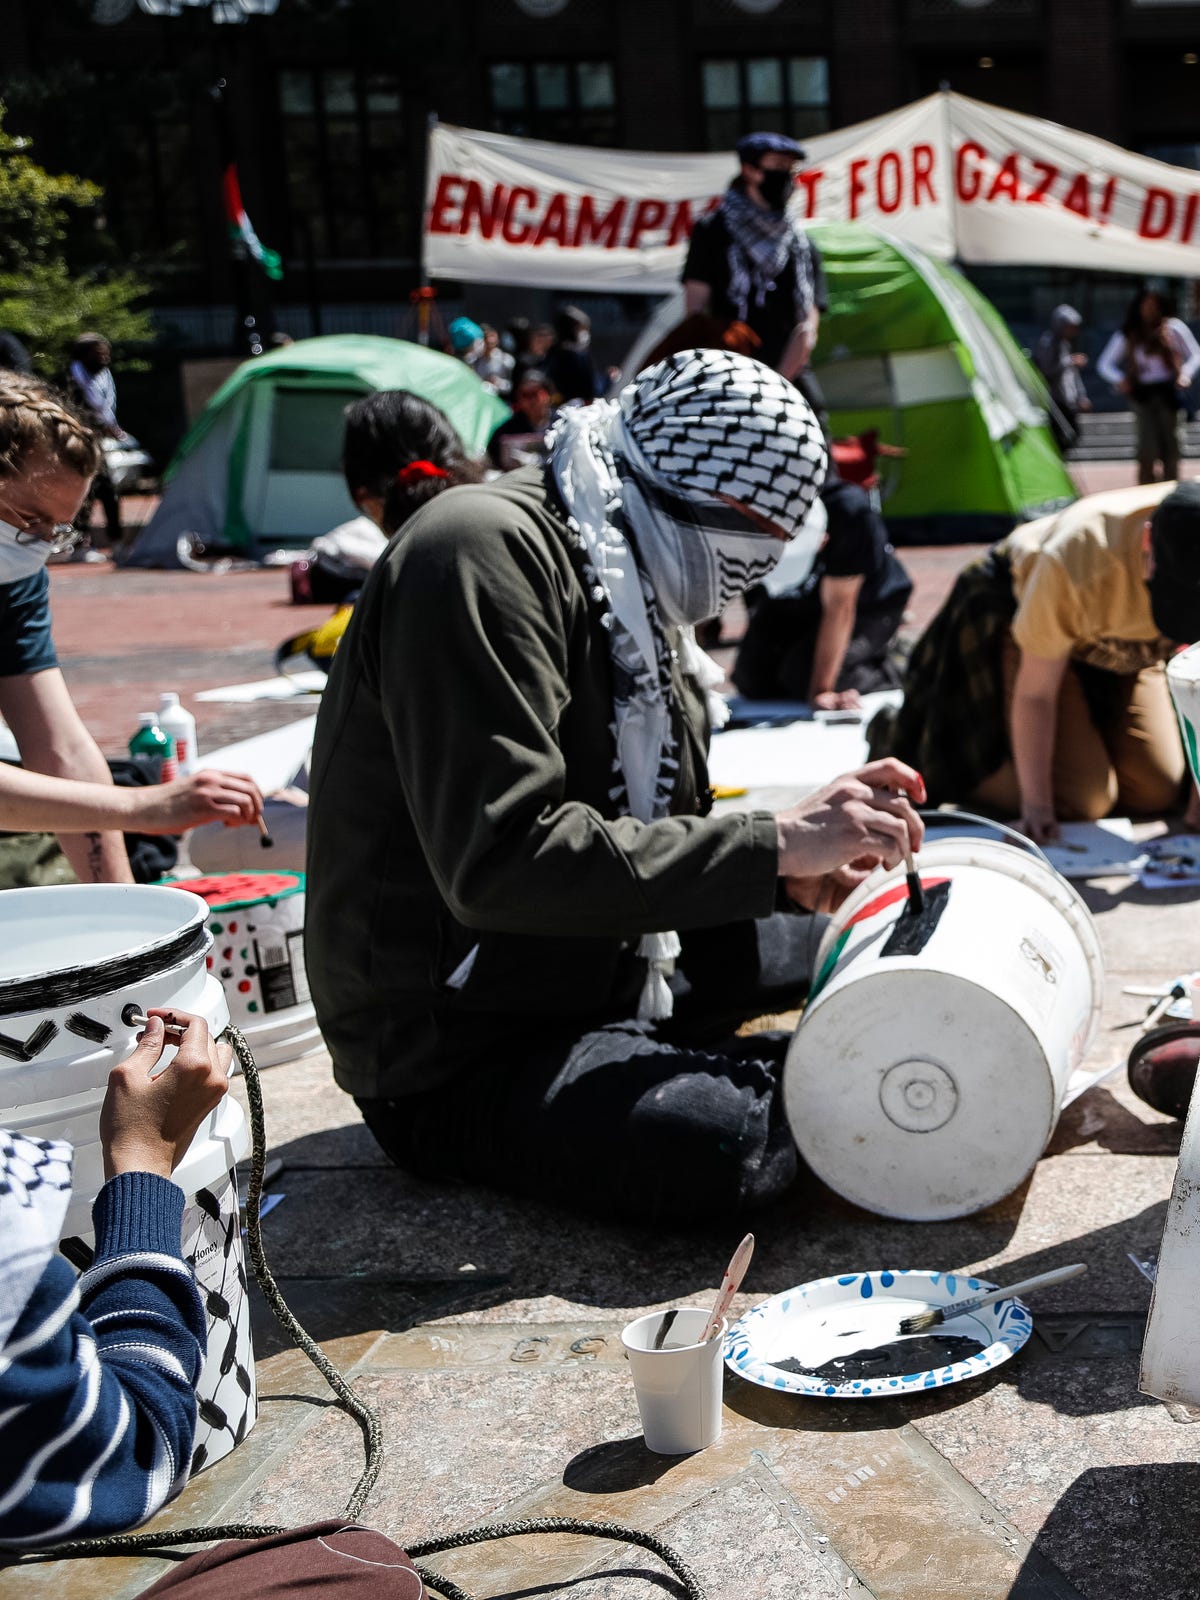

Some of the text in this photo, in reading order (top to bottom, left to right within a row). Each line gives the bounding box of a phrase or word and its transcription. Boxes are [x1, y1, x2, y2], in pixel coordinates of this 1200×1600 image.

[848, 143, 938, 221] FOR
[954, 141, 1115, 227] GAZA!
[194, 1241, 219, 1261] Honey
